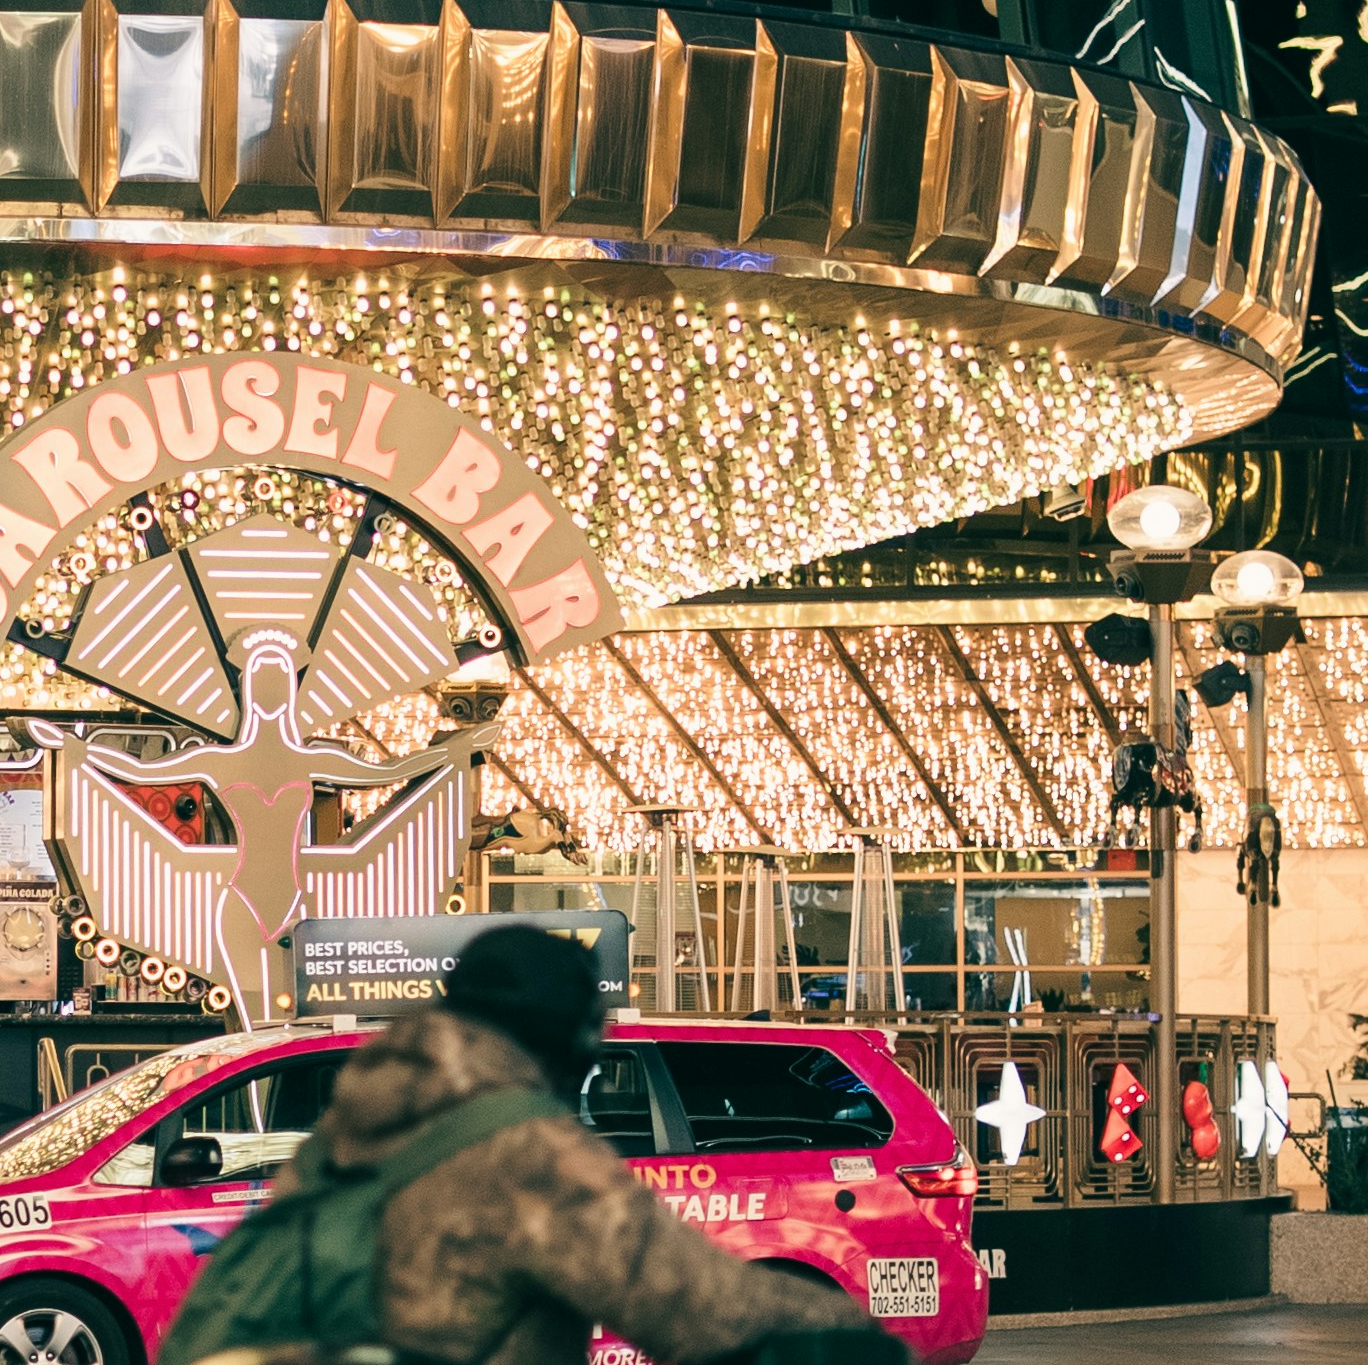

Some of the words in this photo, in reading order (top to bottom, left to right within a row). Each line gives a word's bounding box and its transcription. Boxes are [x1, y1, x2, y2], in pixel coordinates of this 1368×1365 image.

[410, 425, 602, 656] BAR
[19, 888, 55, 898] COLADA
[304, 942, 344, 957] BEST
[347, 940, 410, 957] PRICES,
[305, 959, 344, 976] BEST
[347, 957, 439, 975] SELECTION
[306, 981, 349, 1002] ALL
[348, 979, 433, 1002] THINGS
[597, 980, 624, 993] OM
[978, 1248, 1007, 1279] AR
[869, 1260, 937, 1294] CHECKER
[871, 1295, 937, 1315] 702-551-5151
